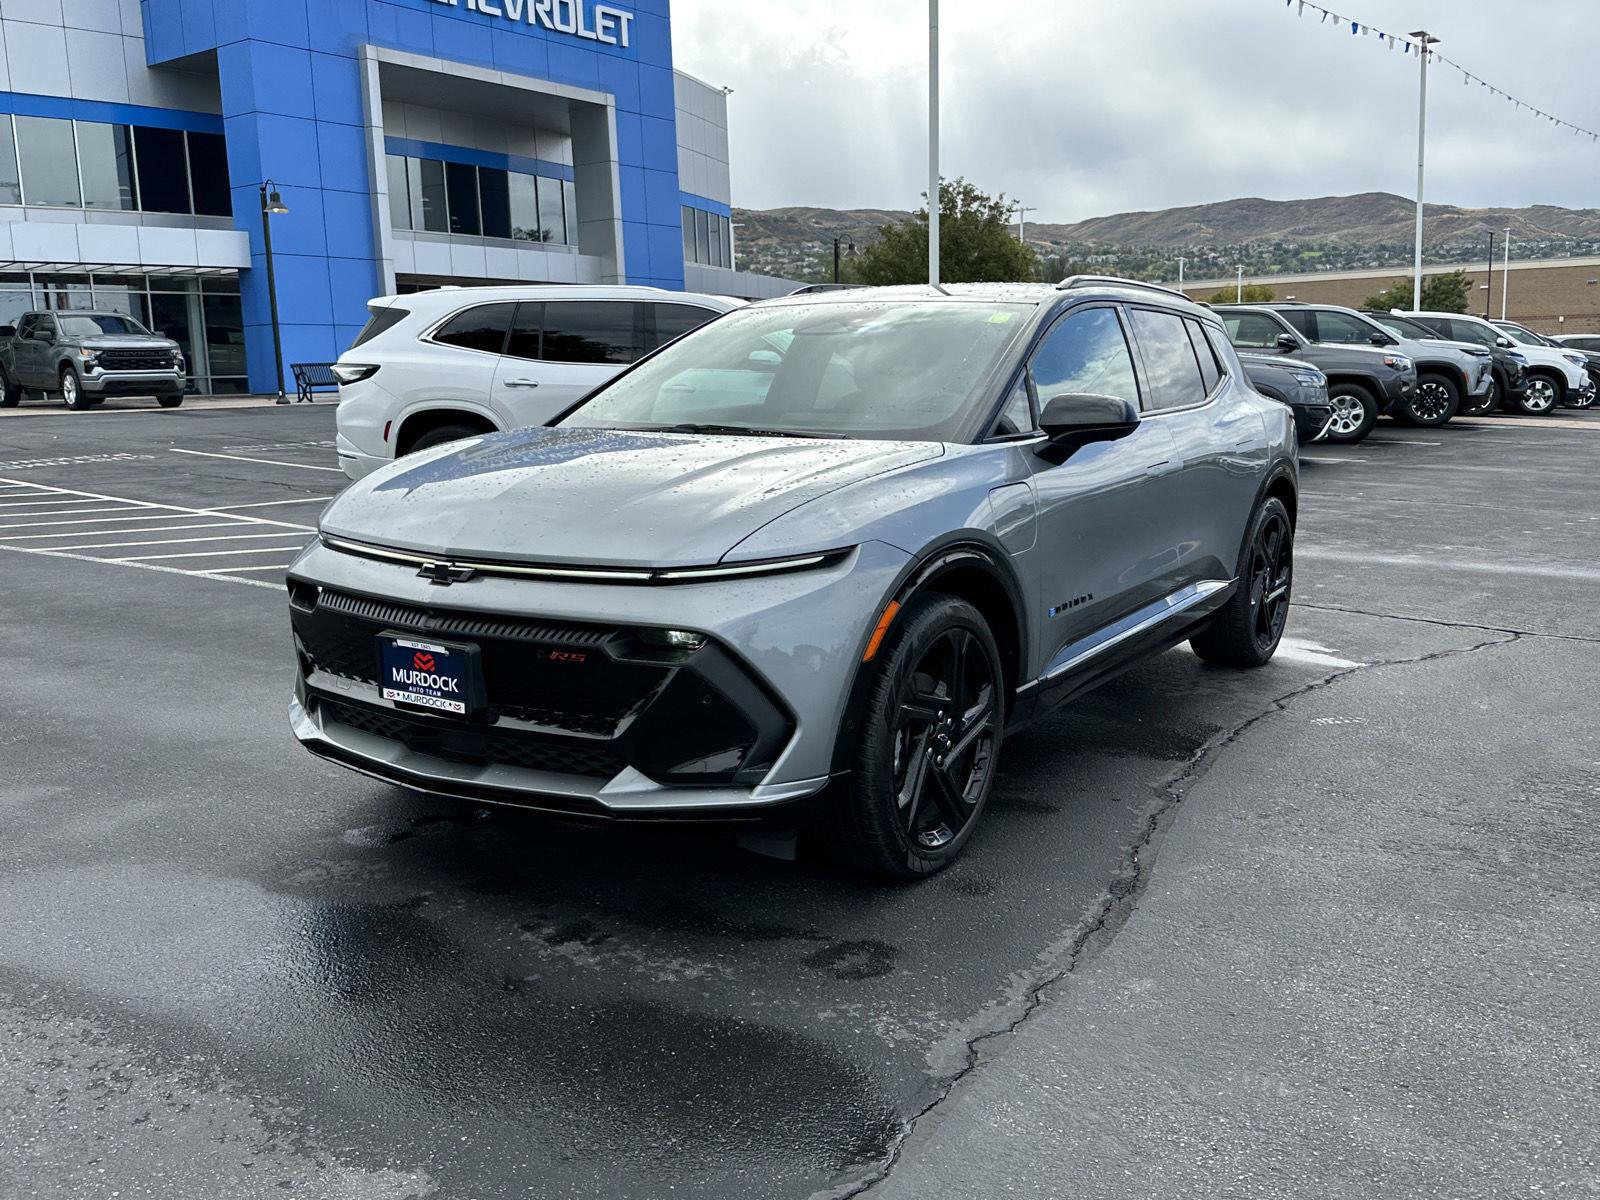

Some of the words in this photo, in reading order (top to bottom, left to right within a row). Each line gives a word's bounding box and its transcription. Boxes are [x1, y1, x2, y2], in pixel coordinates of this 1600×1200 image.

[430, 0, 634, 47] VROLET
[549, 651, 587, 661] RS
[392, 667, 459, 693] MURDOCK
[402, 693, 447, 708] MURDOCK
[426, 689, 442, 697] TEAM
